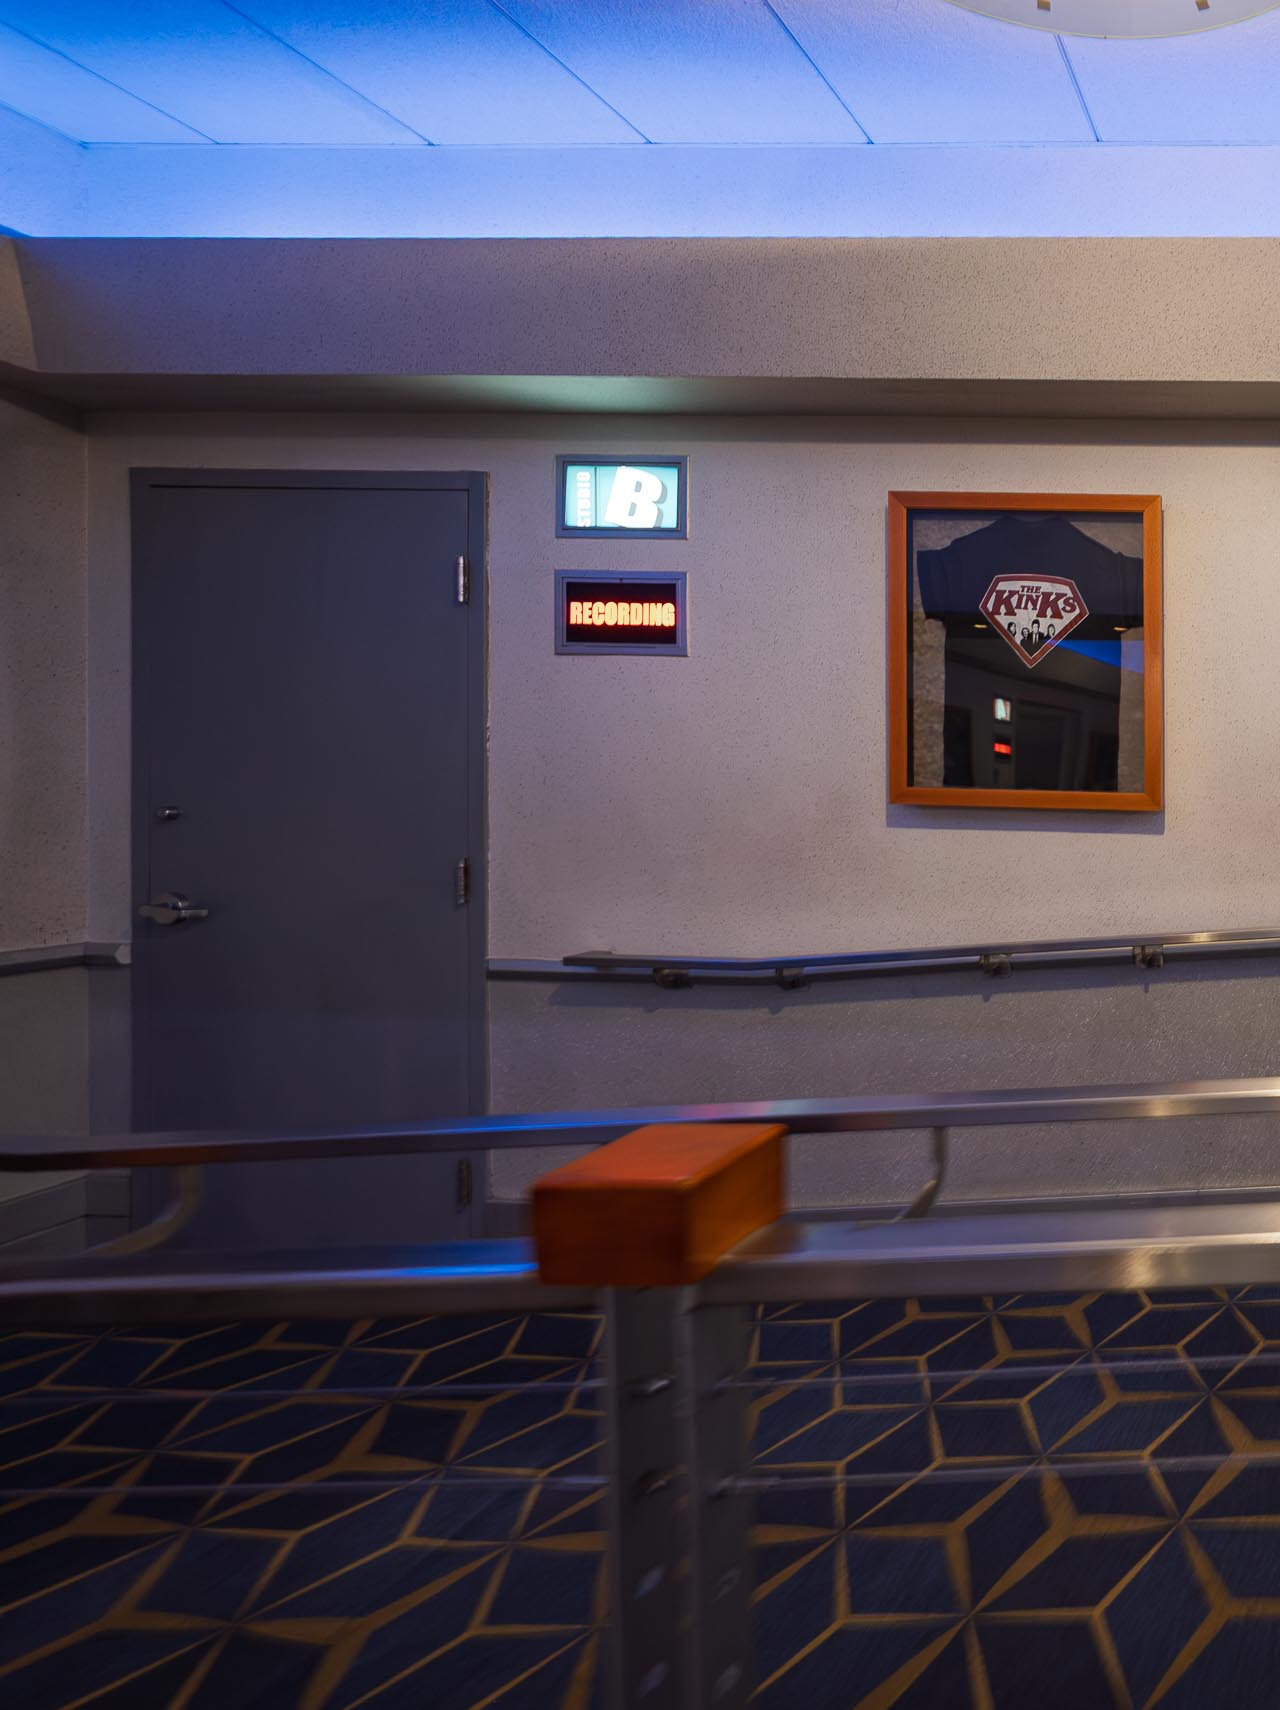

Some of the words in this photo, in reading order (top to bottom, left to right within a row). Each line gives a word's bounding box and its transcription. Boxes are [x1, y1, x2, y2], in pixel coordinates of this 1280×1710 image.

[576, 471, 592, 528] STUDIO
[604, 465, 667, 529] B
[1020, 585, 1042, 594] THE
[569, 601, 676, 627] RECORDING
